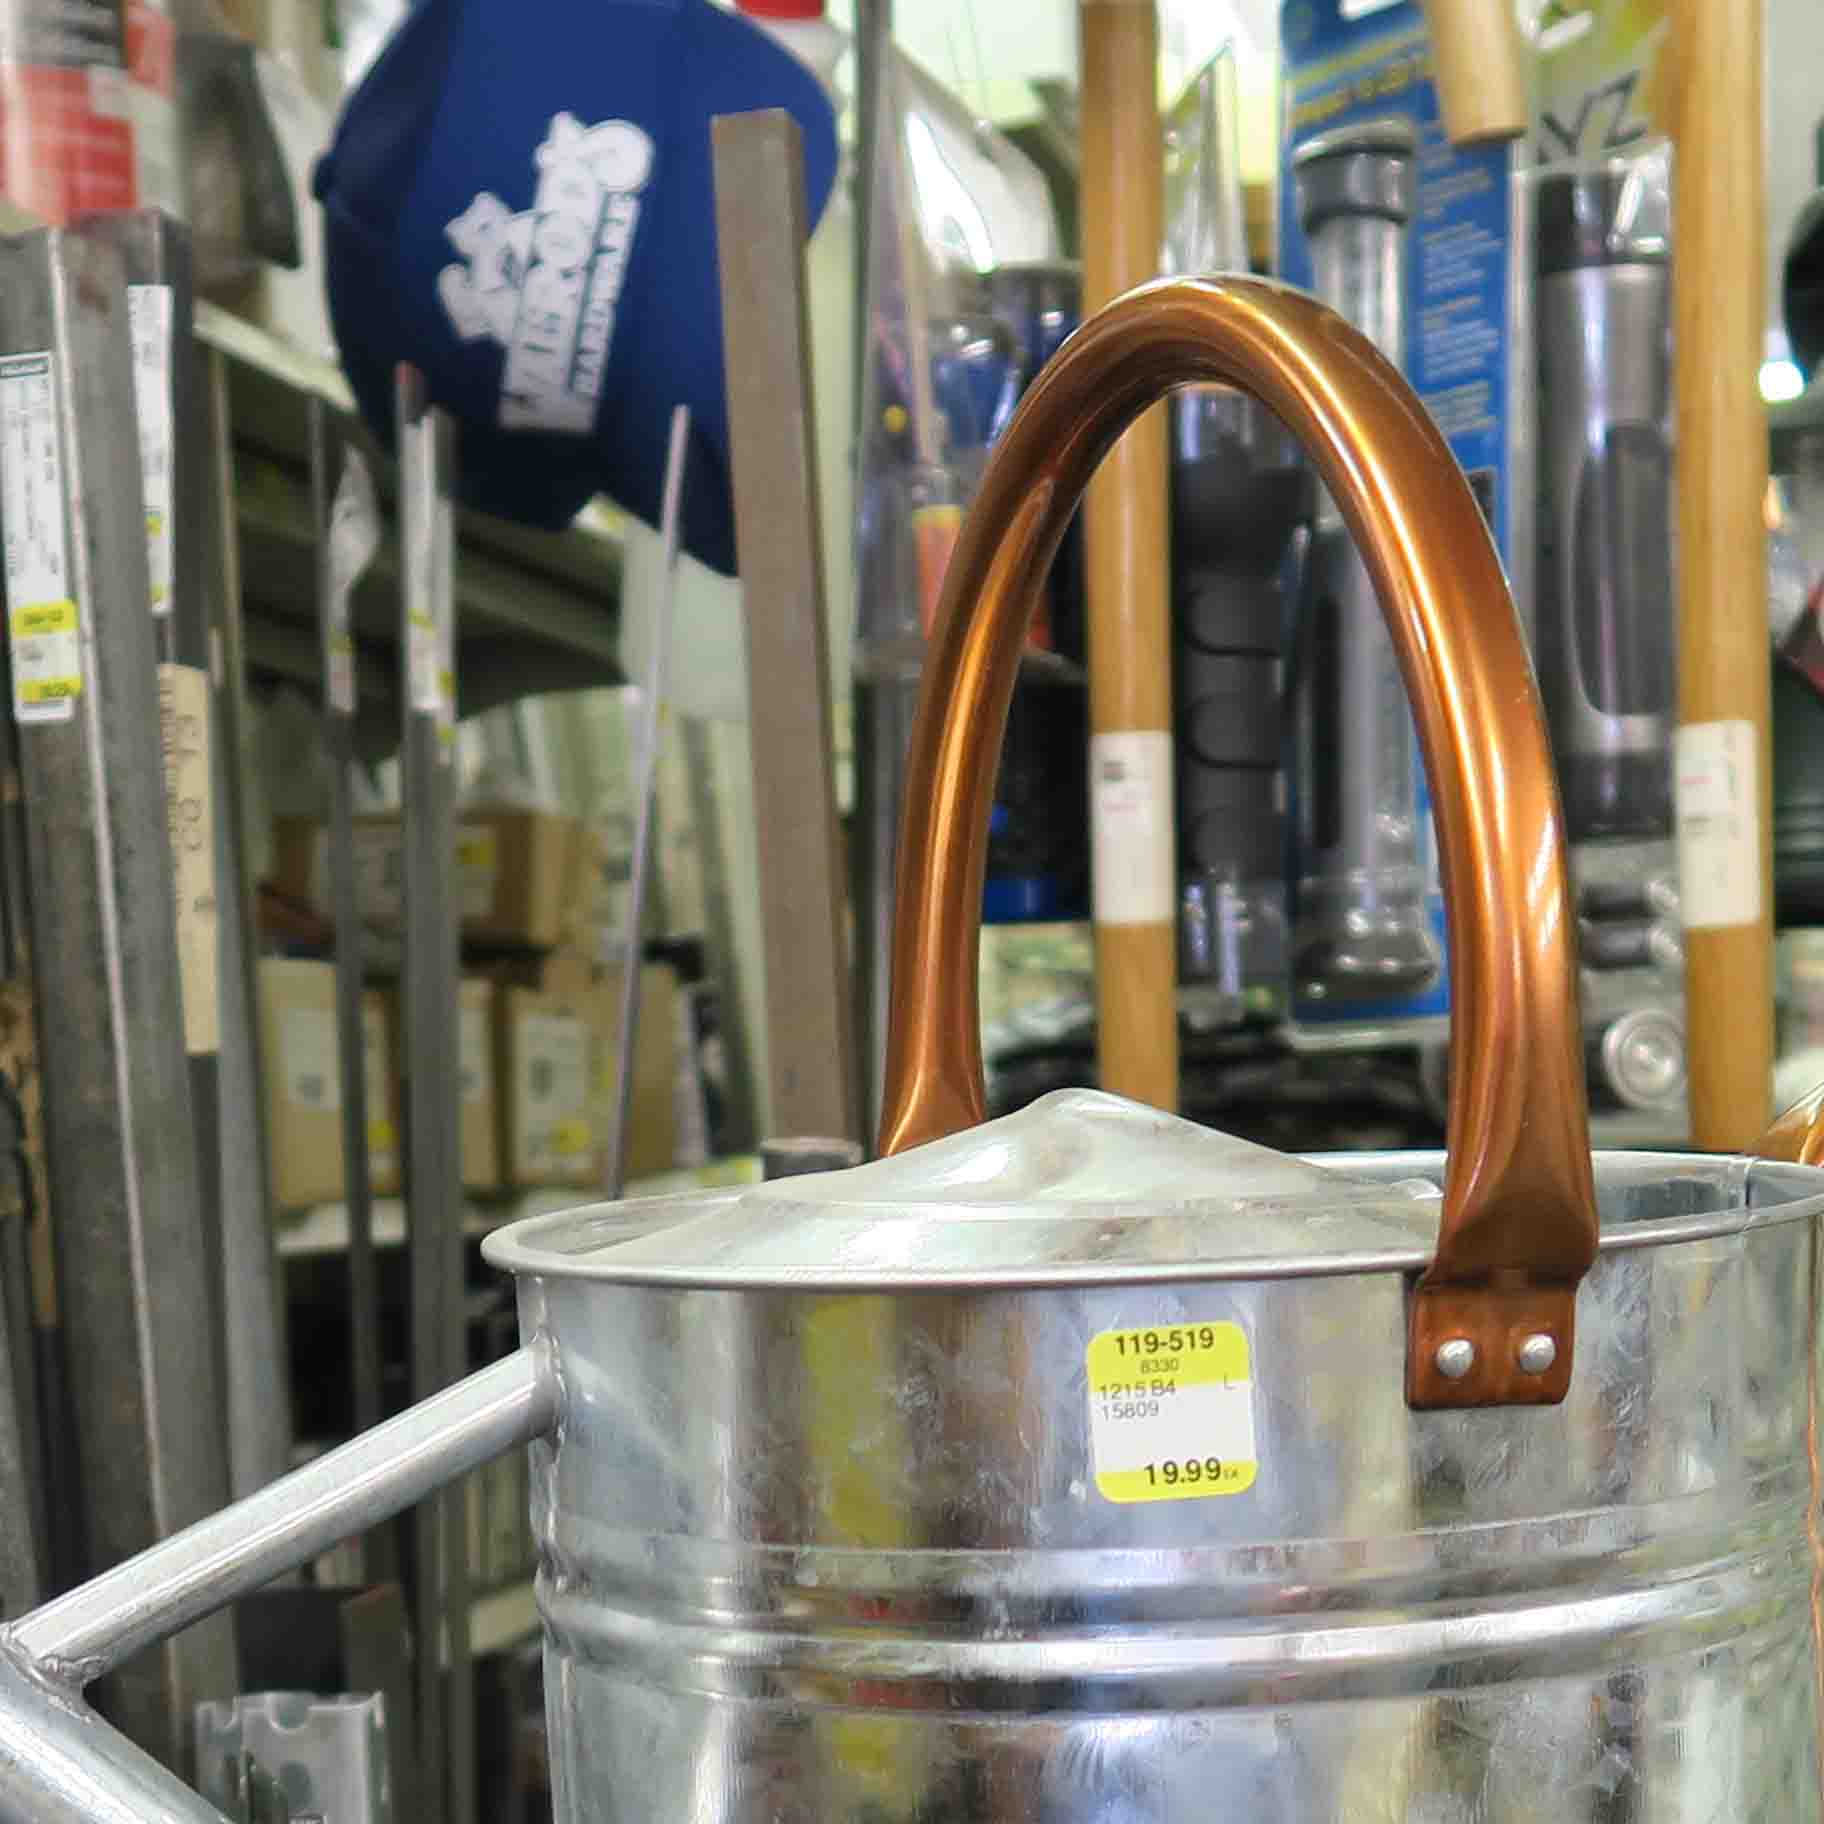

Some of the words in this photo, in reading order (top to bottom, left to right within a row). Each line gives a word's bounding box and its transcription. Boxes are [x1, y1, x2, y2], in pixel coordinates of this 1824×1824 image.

[1115, 1327, 1215, 1356] 119-519
[1099, 1380, 1147, 1401] 1215
[1151, 1377, 1177, 1397] B4
[1224, 1372, 1237, 1391] L
[1101, 1400, 1160, 1421] 15809
[1143, 1457, 1222, 1486] 19.99
